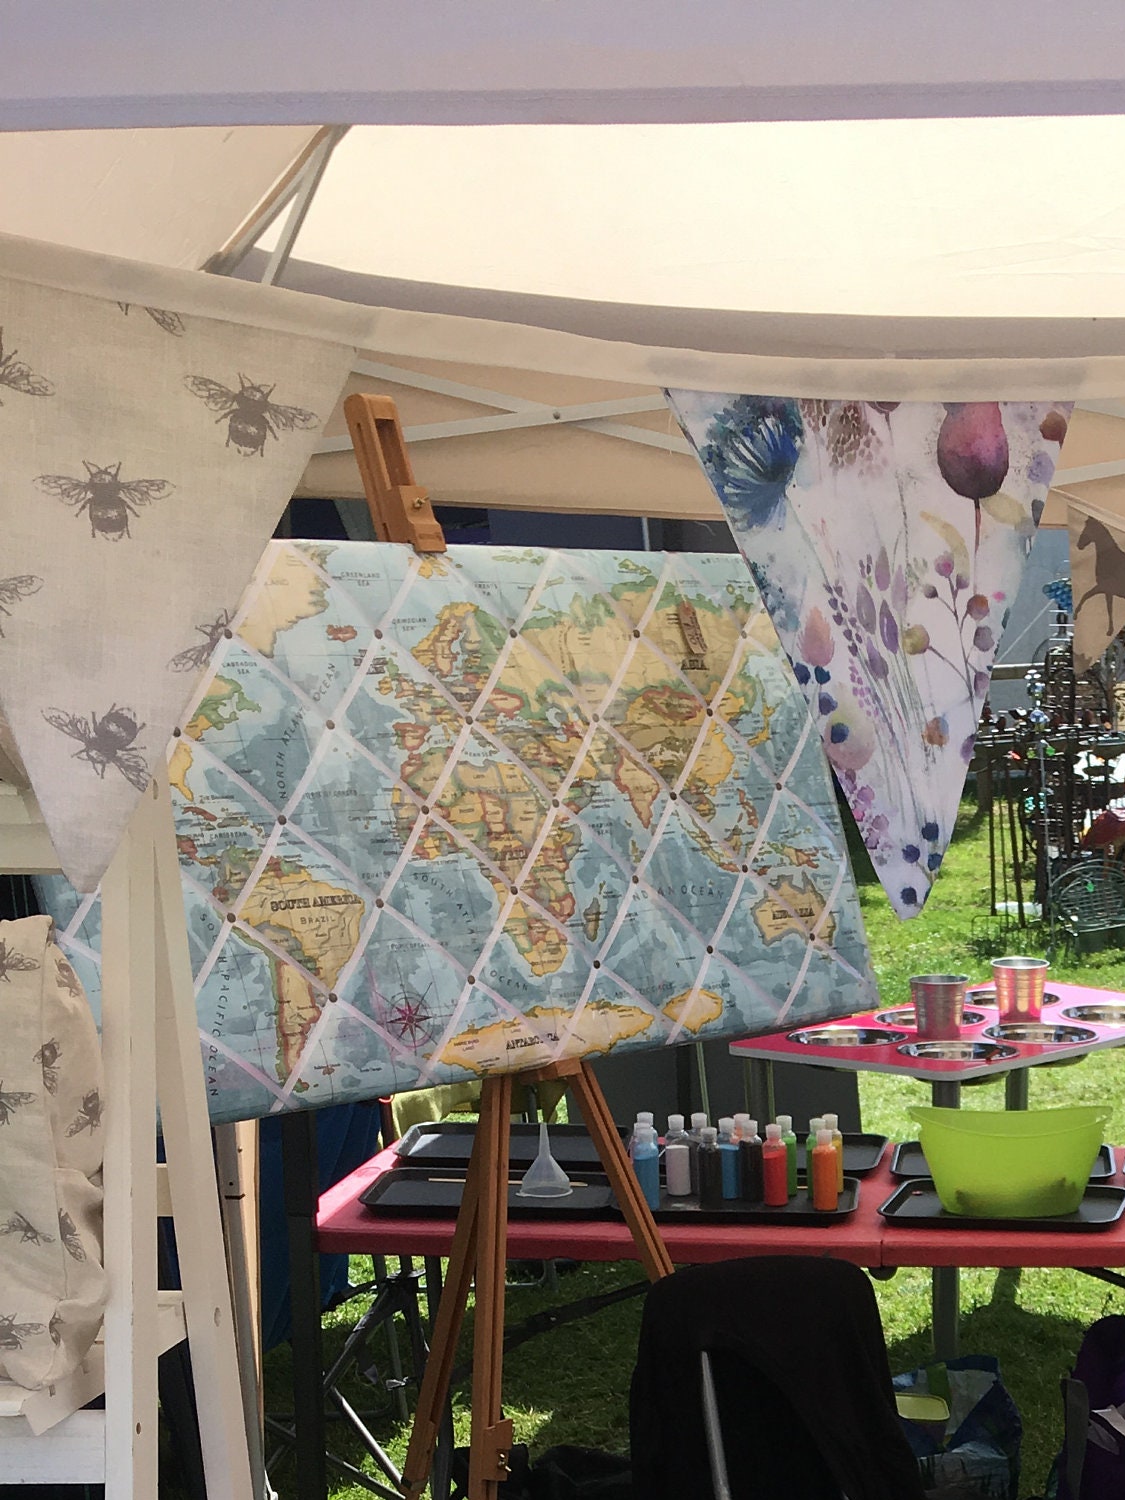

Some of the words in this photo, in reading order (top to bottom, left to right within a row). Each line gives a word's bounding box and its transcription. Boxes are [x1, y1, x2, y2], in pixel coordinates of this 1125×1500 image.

[274, 752, 288, 800] NORTH
[313, 663, 336, 701] OCEAN
[270, 897, 311, 912] SOUTH
[312, 894, 362, 908] AMERICA
[680, 884, 725, 900] OCEAN
[300, 916, 336, 925] BRAZIL
[489, 970, 529, 992] OCEAN
[211, 972, 230, 1038] PACIFIC
[207, 1045, 219, 1097] OCEAN
